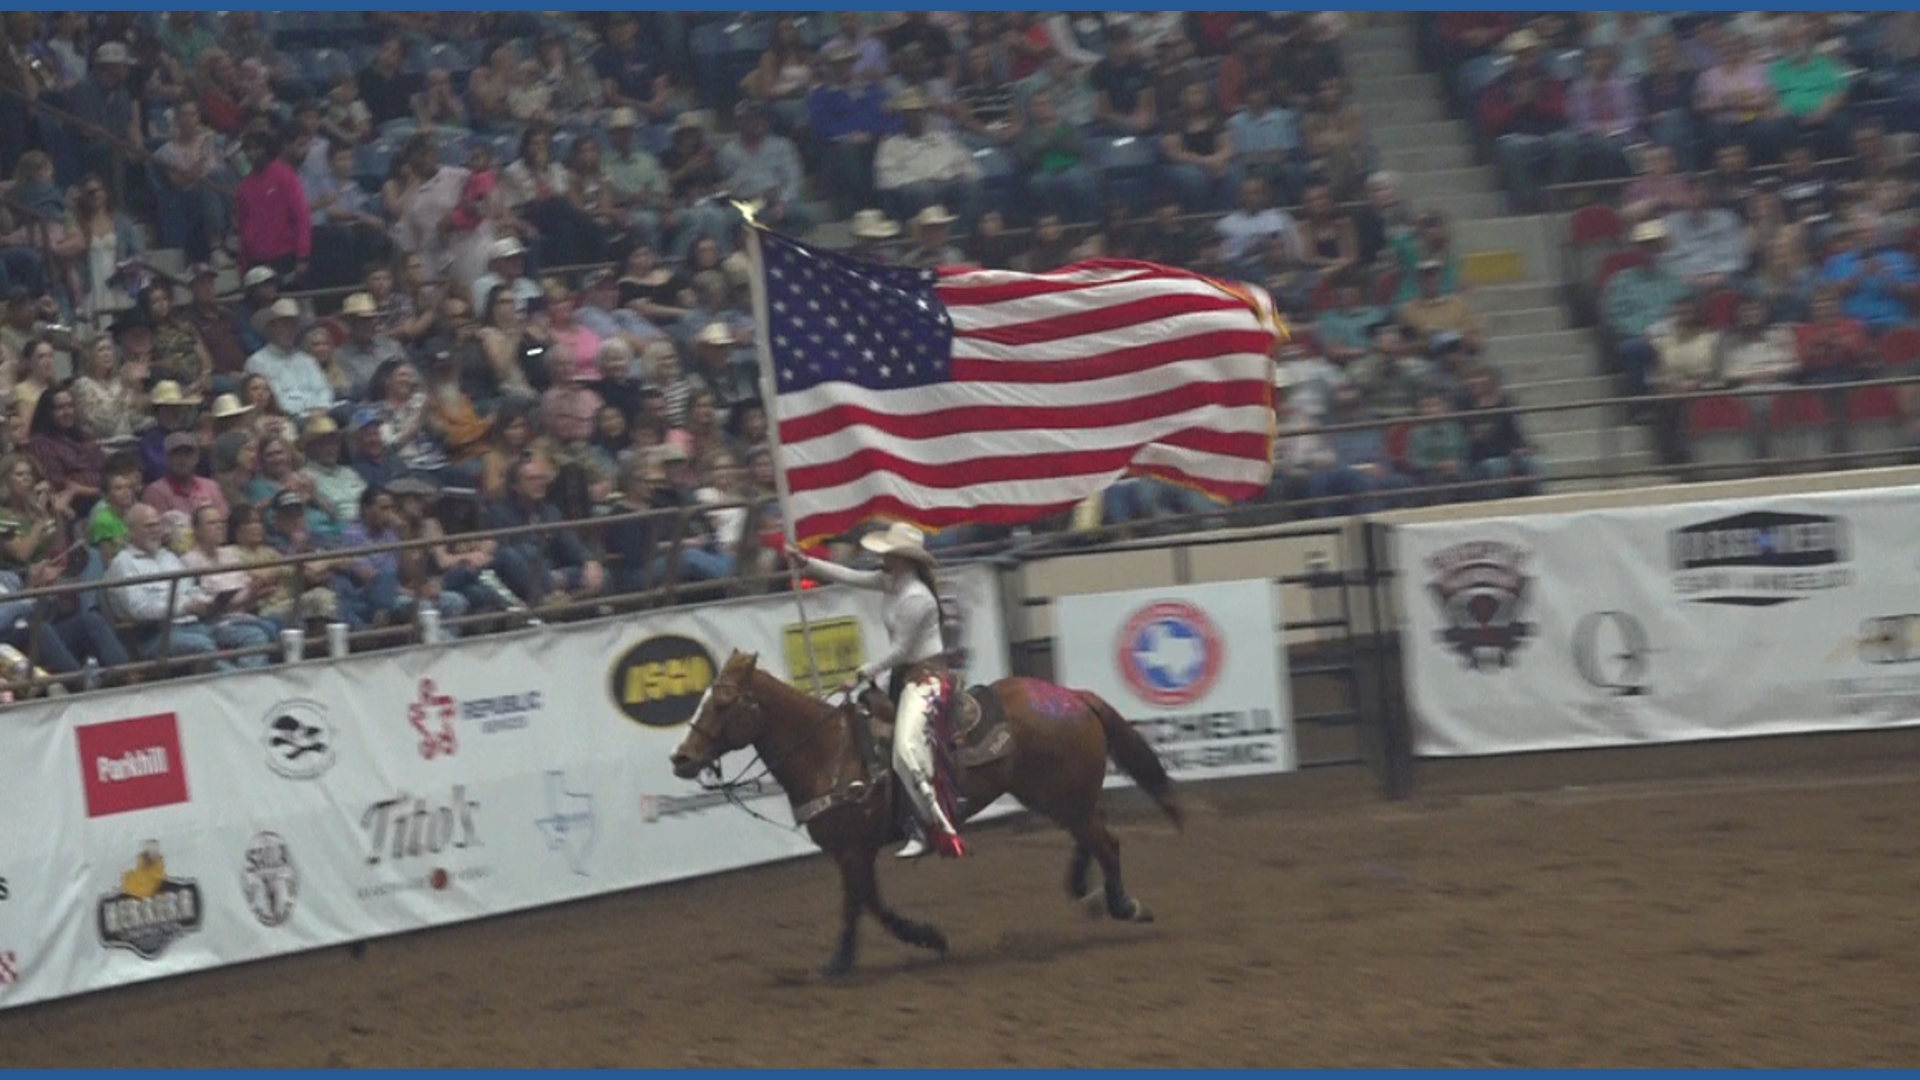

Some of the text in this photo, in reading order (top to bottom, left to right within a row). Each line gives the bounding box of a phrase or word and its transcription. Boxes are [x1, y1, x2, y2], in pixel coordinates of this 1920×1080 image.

[1126, 706, 1276, 744] CHELL
[97, 747, 168, 783] Parkhill
[359, 784, 485, 866] Tito's
